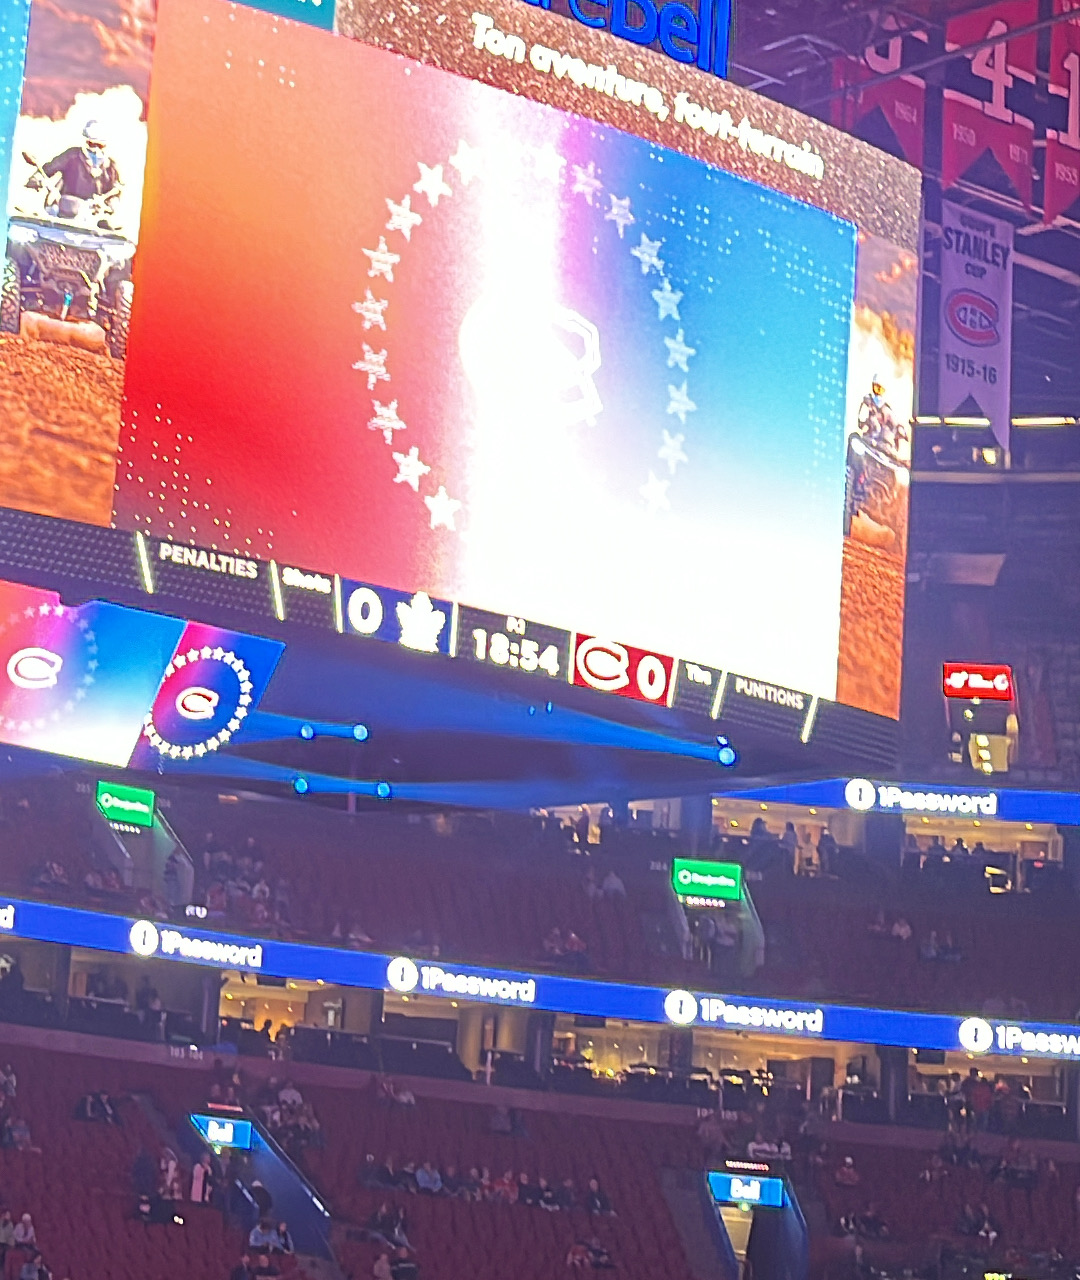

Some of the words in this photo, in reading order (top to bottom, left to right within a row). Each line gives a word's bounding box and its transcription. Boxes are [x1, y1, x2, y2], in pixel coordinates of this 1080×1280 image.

[471, 12, 526, 63] Ton
[971, 20, 1013, 123] 4
[943, 227, 1011, 270] STANLEY
[945, 353, 997, 385] 1915-16
[159, 541, 258, 579] PENALTIES
[282, 567, 332, 594] Shots
[347, 587, 383, 634] 0
[472, 628, 560, 676] 18:54
[637, 655, 667, 700] 0
[735, 678, 805, 711] PUNITIONS
[878, 784, 998, 818] 1Password
[418, 961, 536, 1005] 1Password
[700, 997, 824, 1033] 1Password
